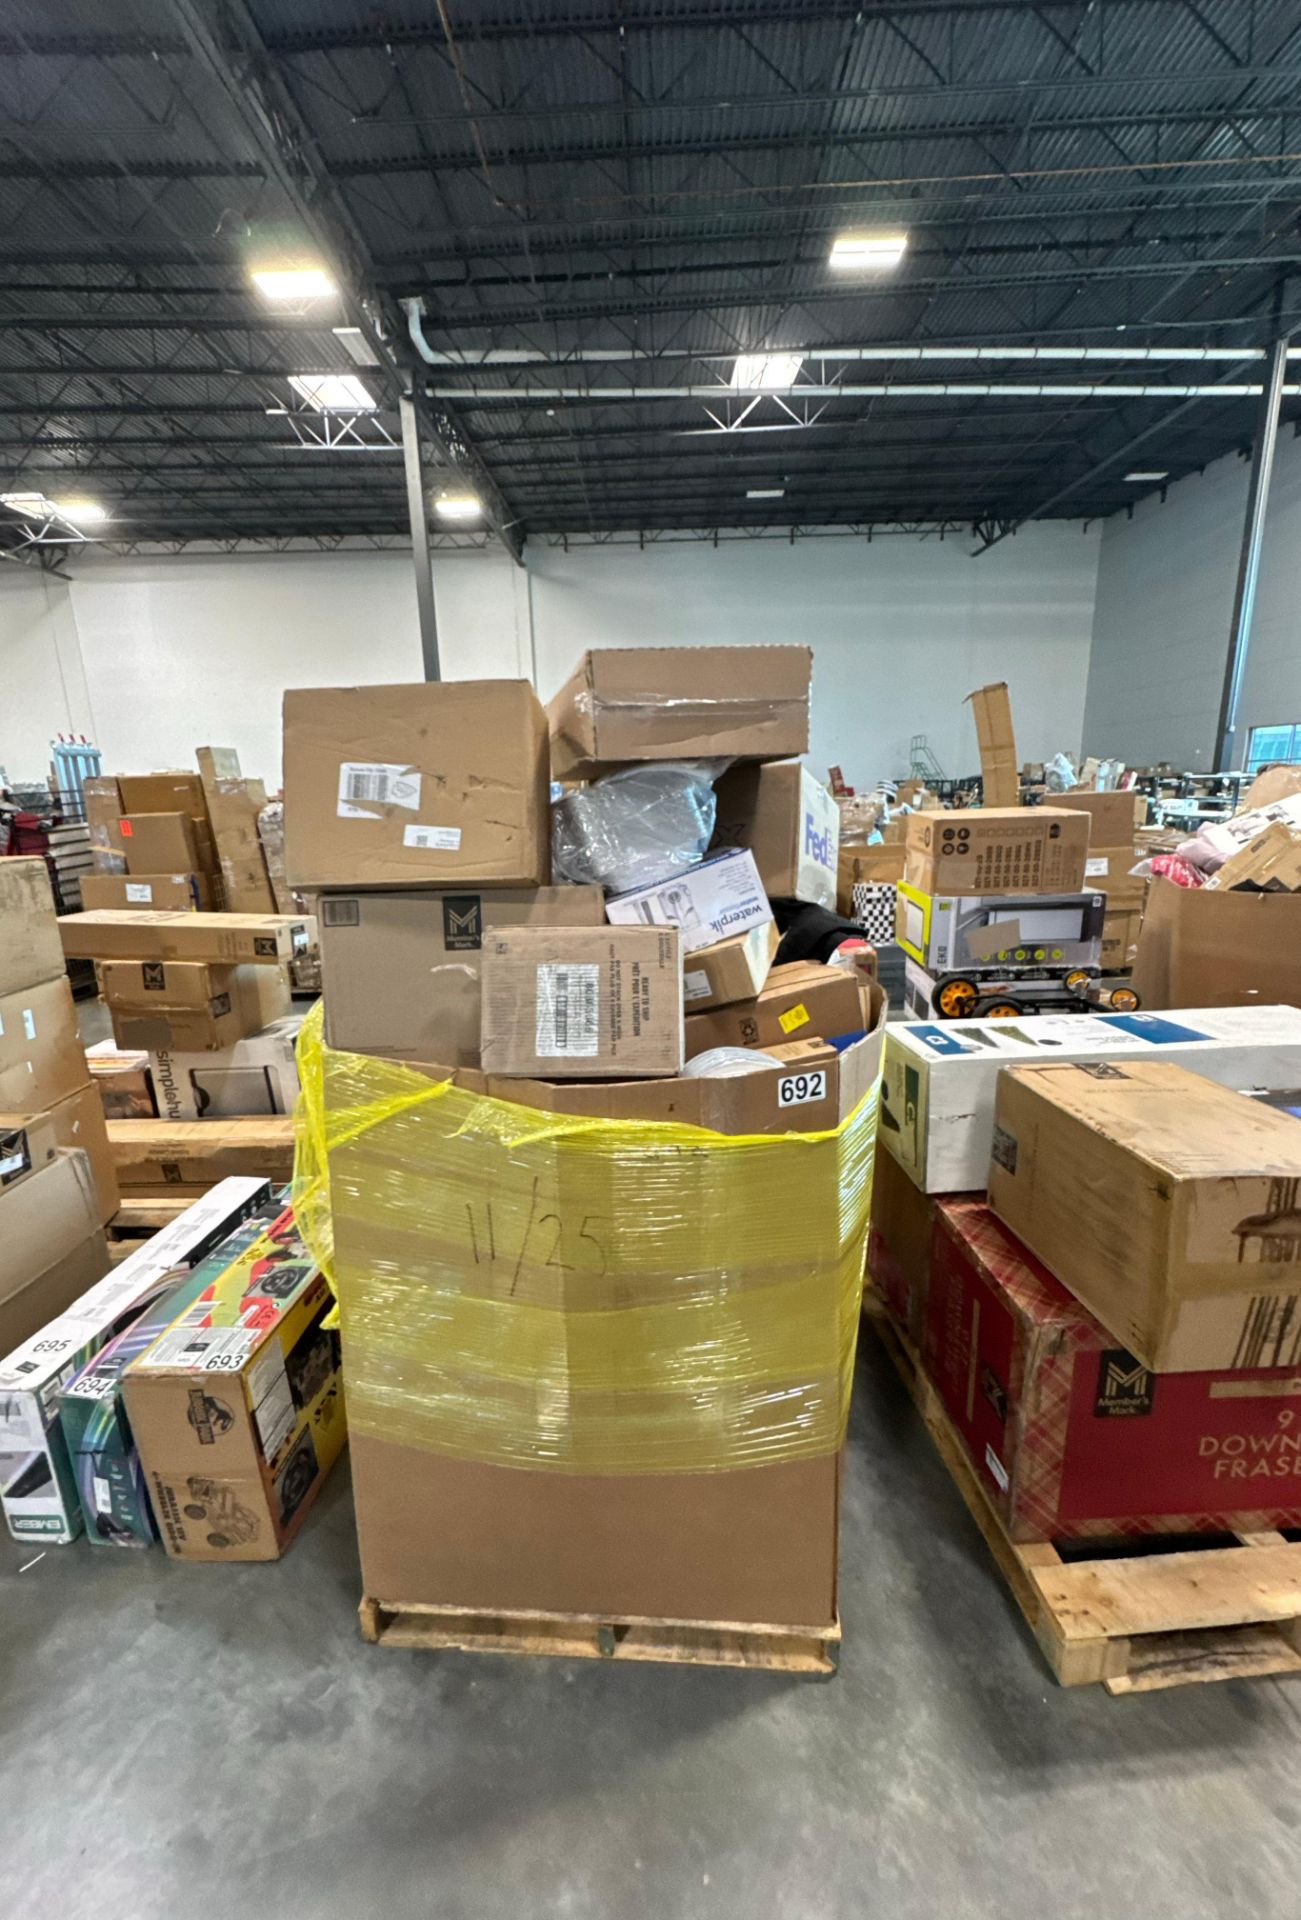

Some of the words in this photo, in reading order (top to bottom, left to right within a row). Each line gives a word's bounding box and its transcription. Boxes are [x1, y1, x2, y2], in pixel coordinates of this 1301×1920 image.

[710, 904, 763, 935] waterpik
[937, 946, 948, 964] EKO
[641, 998, 649, 1006] TO
[156, 1050, 181, 1119] simplehu
[781, 1073, 822, 1103] 692
[465, 1176, 618, 1297] 11/25
[33, 1339, 73, 1352] 695
[206, 1354, 244, 1370] 693
[73, 1377, 112, 1395] 694
[1098, 1396, 1150, 1407] Member's
[1108, 1405, 1137, 1415] Mark
[1277, 1409, 1296, 1430] 9
